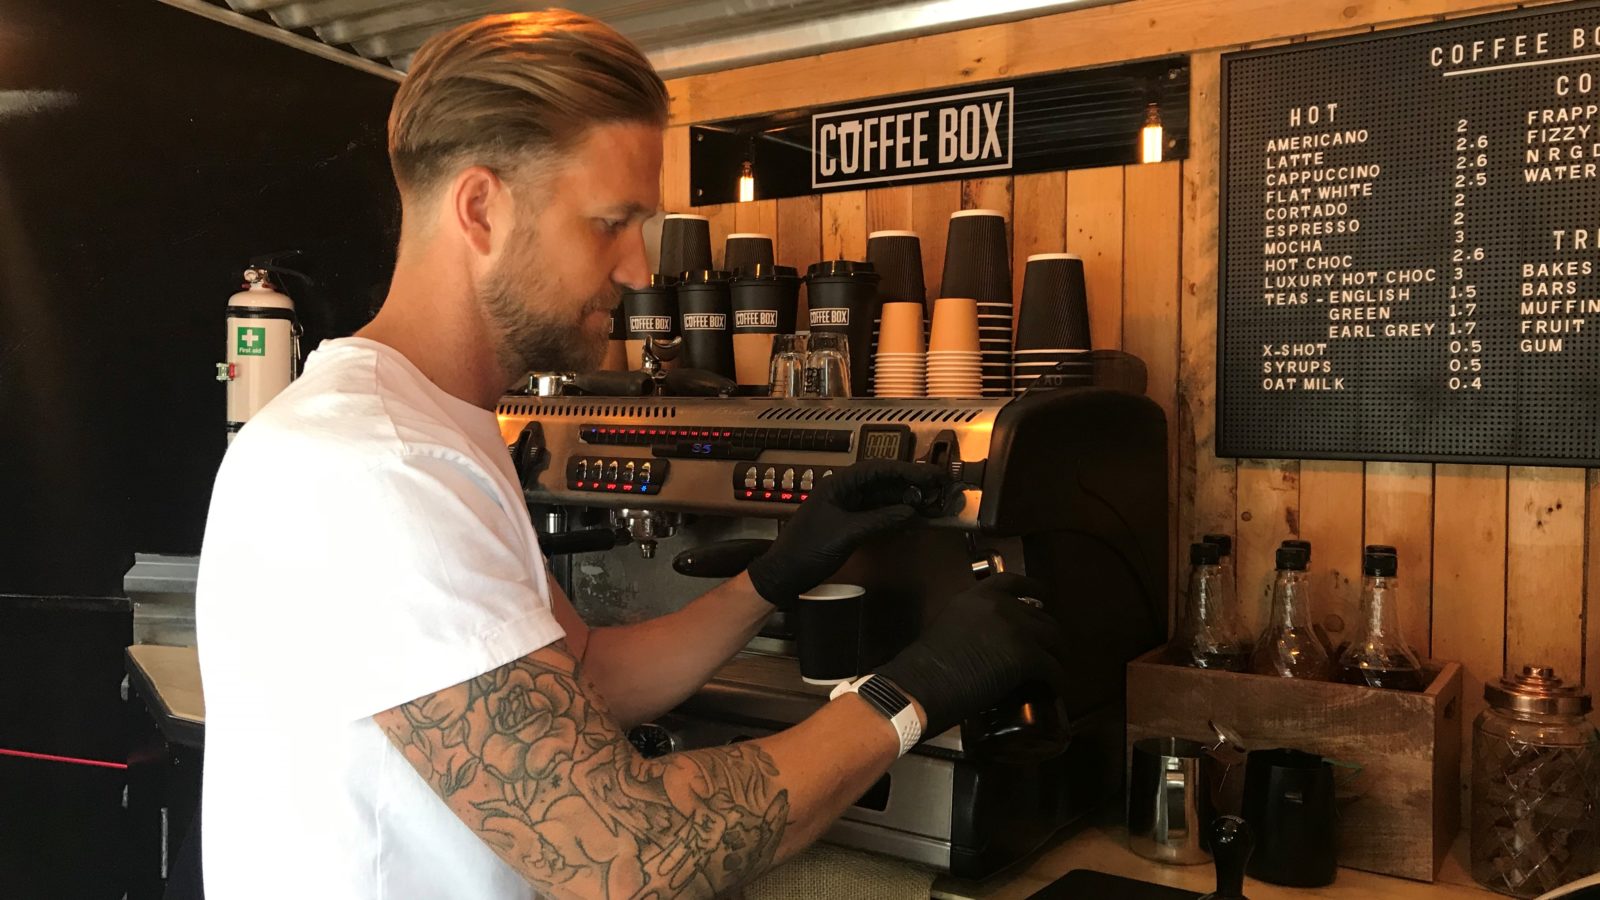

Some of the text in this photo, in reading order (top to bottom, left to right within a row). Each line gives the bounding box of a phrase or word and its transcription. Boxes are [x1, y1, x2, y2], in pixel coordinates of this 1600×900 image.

[1432, 33, 1548, 67] COFFEE
[1291, 103, 1337, 127] HOT
[1528, 105, 1597, 125] FRAPP
[820, 102, 1003, 176] COFFEE BOX
[1267, 119, 1467, 152] AMERICANO 2
[1528, 125, 1590, 144] FIZZY
[1267, 135, 1488, 169] LATTE 2.6
[1266, 154, 1487, 188] CAPPUCCINO 2.6
[1524, 164, 1596, 182] WATER
[1267, 173, 1486, 203] FLAT WHITE 2.5
[1266, 194, 1464, 220] CORTADO 2
[1266, 212, 1464, 238] ESPRESSO 2
[1265, 231, 1464, 254] MOCHA 3
[1553, 228, 1600, 250] TR
[1266, 248, 1484, 271] HOT CHOC 2.6
[1265, 267, 1462, 288] LUXURY HOT CHOC 3
[1523, 262, 1591, 277] BAKES
[1265, 293, 1307, 305] TEAS
[1330, 288, 1409, 303] ENGLISH
[1450, 285, 1476, 298] 1.5
[1522, 281, 1576, 296] BARS
[1330, 304, 1476, 320] GREEN 1.7
[1521, 300, 1600, 314] MUFFIN
[631, 318, 669, 330] COFFEE BOX
[685, 316, 724, 328] COFFEE BOX
[736, 312, 775, 325] COFFEE BOX
[810, 310, 847, 324] COFFEE BOX
[1522, 319, 1584, 333] FRUIT
[1330, 322, 1476, 338] EARL GREY 1.7
[1263, 341, 1481, 356] X-SHOT 0.5
[1521, 339, 1562, 352] GUM
[1264, 359, 1481, 373] SYRUPS 0.5
[1264, 377, 1481, 390] OAT MILK 0.4
